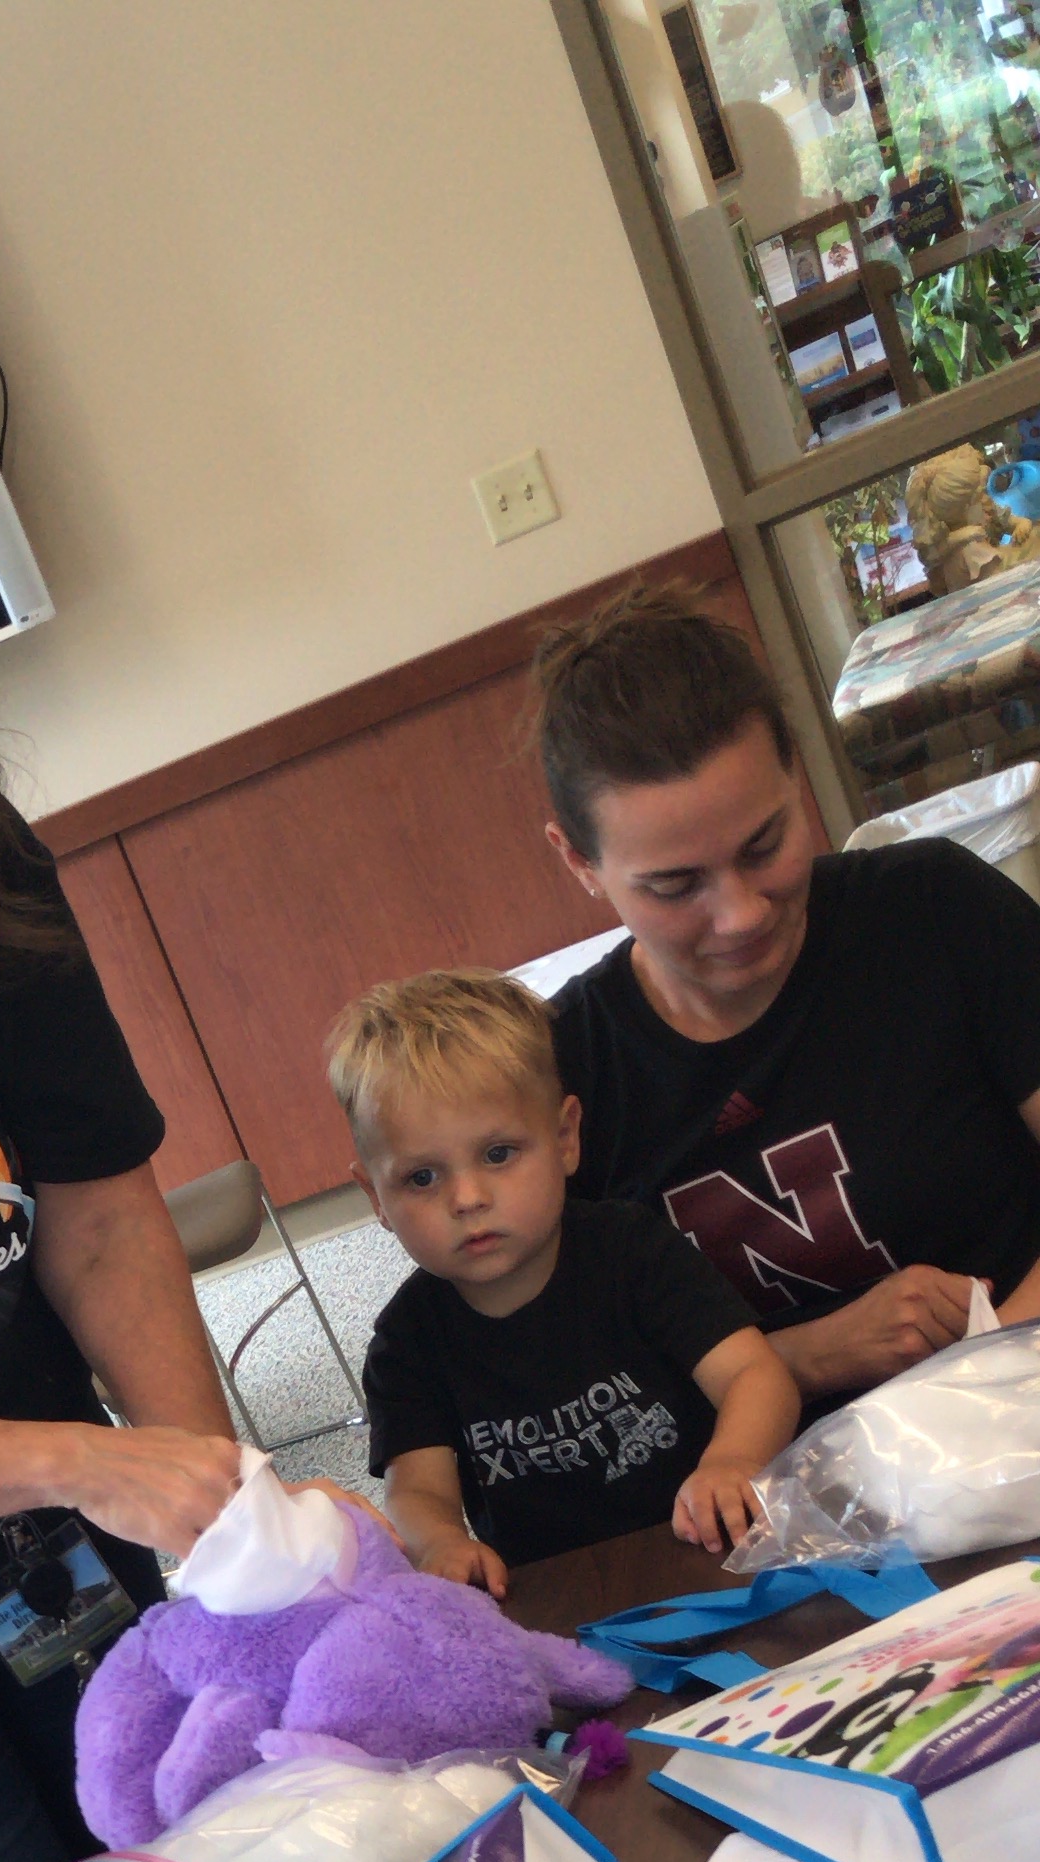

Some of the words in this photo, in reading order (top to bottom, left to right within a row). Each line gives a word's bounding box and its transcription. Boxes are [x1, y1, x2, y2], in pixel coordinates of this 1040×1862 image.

[662, 1122, 898, 1316] N
[463, 1371, 643, 1451] EMOLITION
[471, 1421, 609, 1486] XPERT
